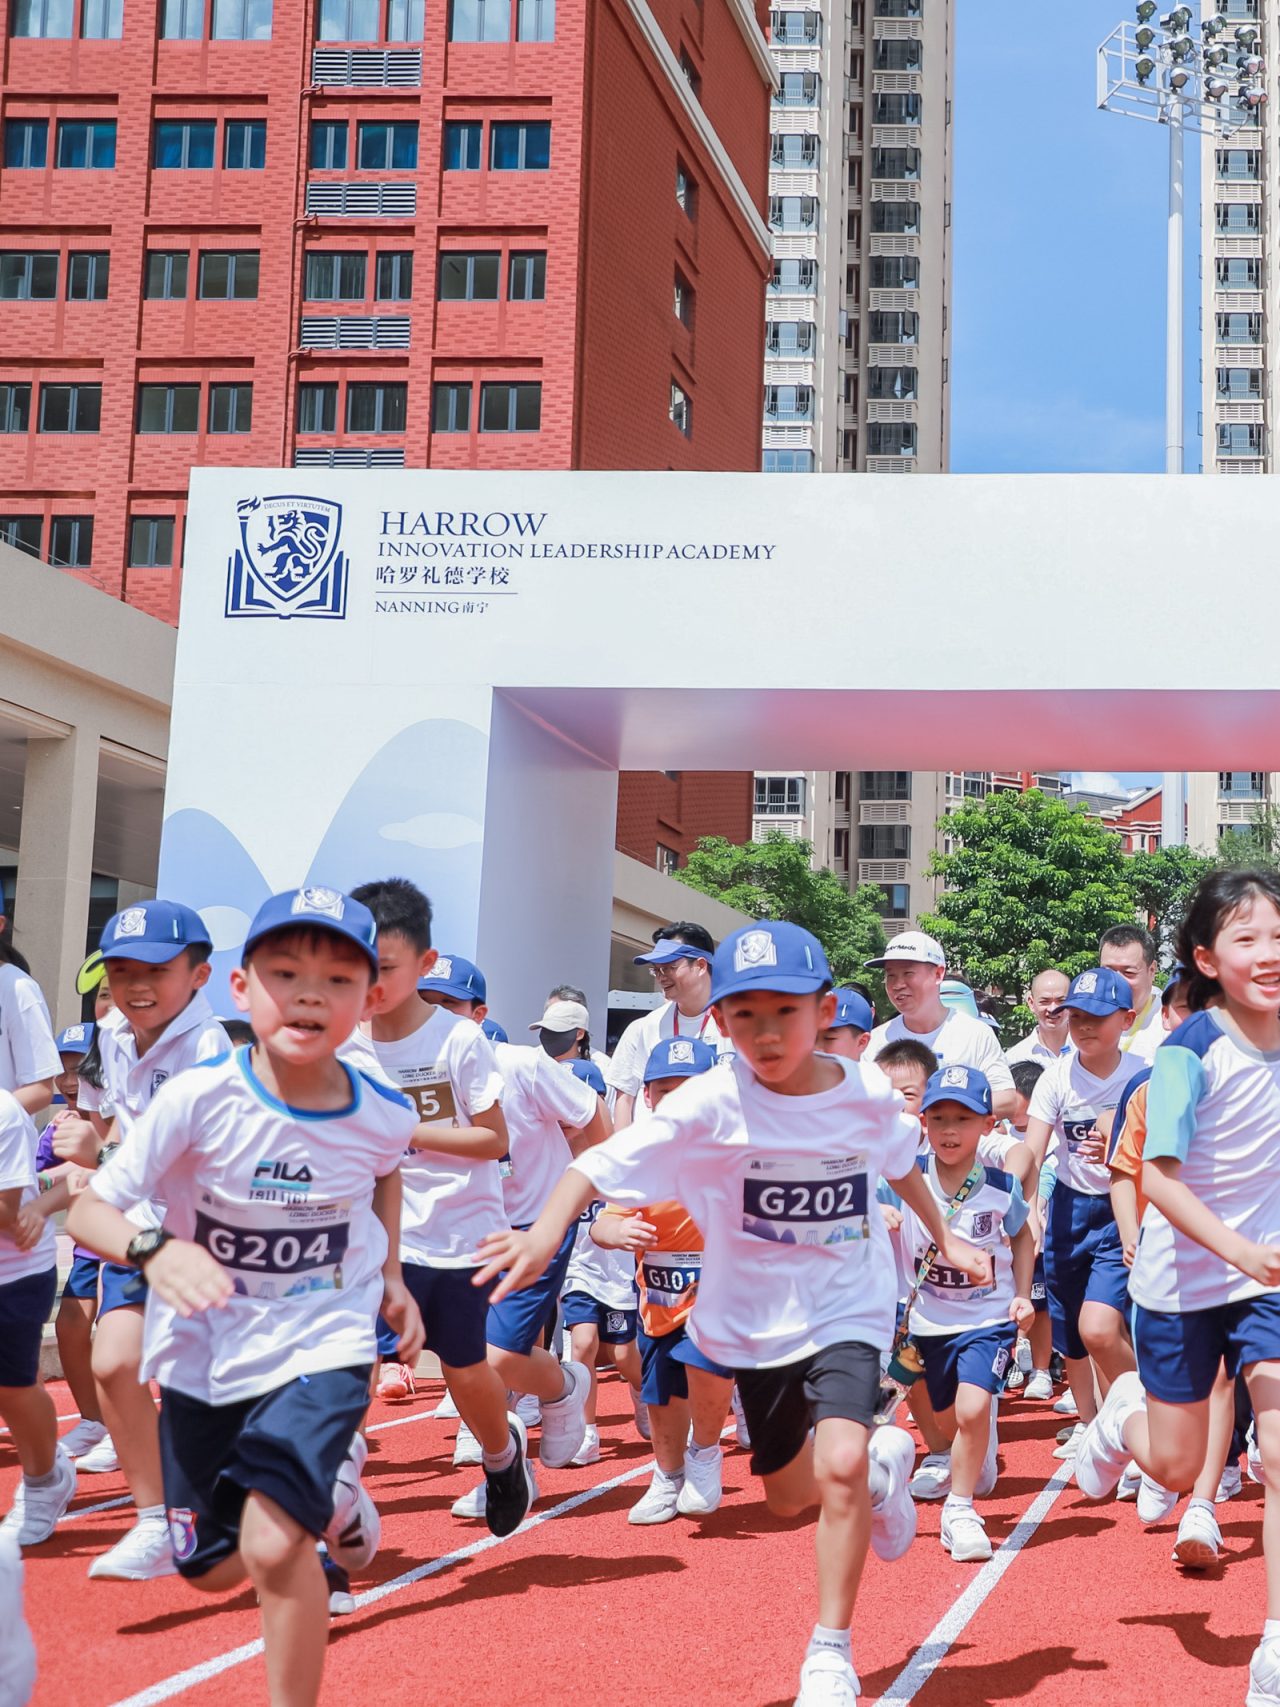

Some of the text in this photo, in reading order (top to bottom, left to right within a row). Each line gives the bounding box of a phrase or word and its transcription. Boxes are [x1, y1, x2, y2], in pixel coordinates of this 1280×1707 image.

[380, 511, 548, 537] HARROW
[378, 542, 776, 560] INNOVATION LEADERSHIP ACADEMY
[376, 565, 509, 585] 哈罗礼德学校
[375, 601, 459, 613] NANNING
[254, 1161, 313, 1182] FILA
[759, 1182, 854, 1216] G202
[208, 1228, 330, 1268] G204
[649, 1269, 697, 1291] G101
[927, 1267, 971, 1286] G11
